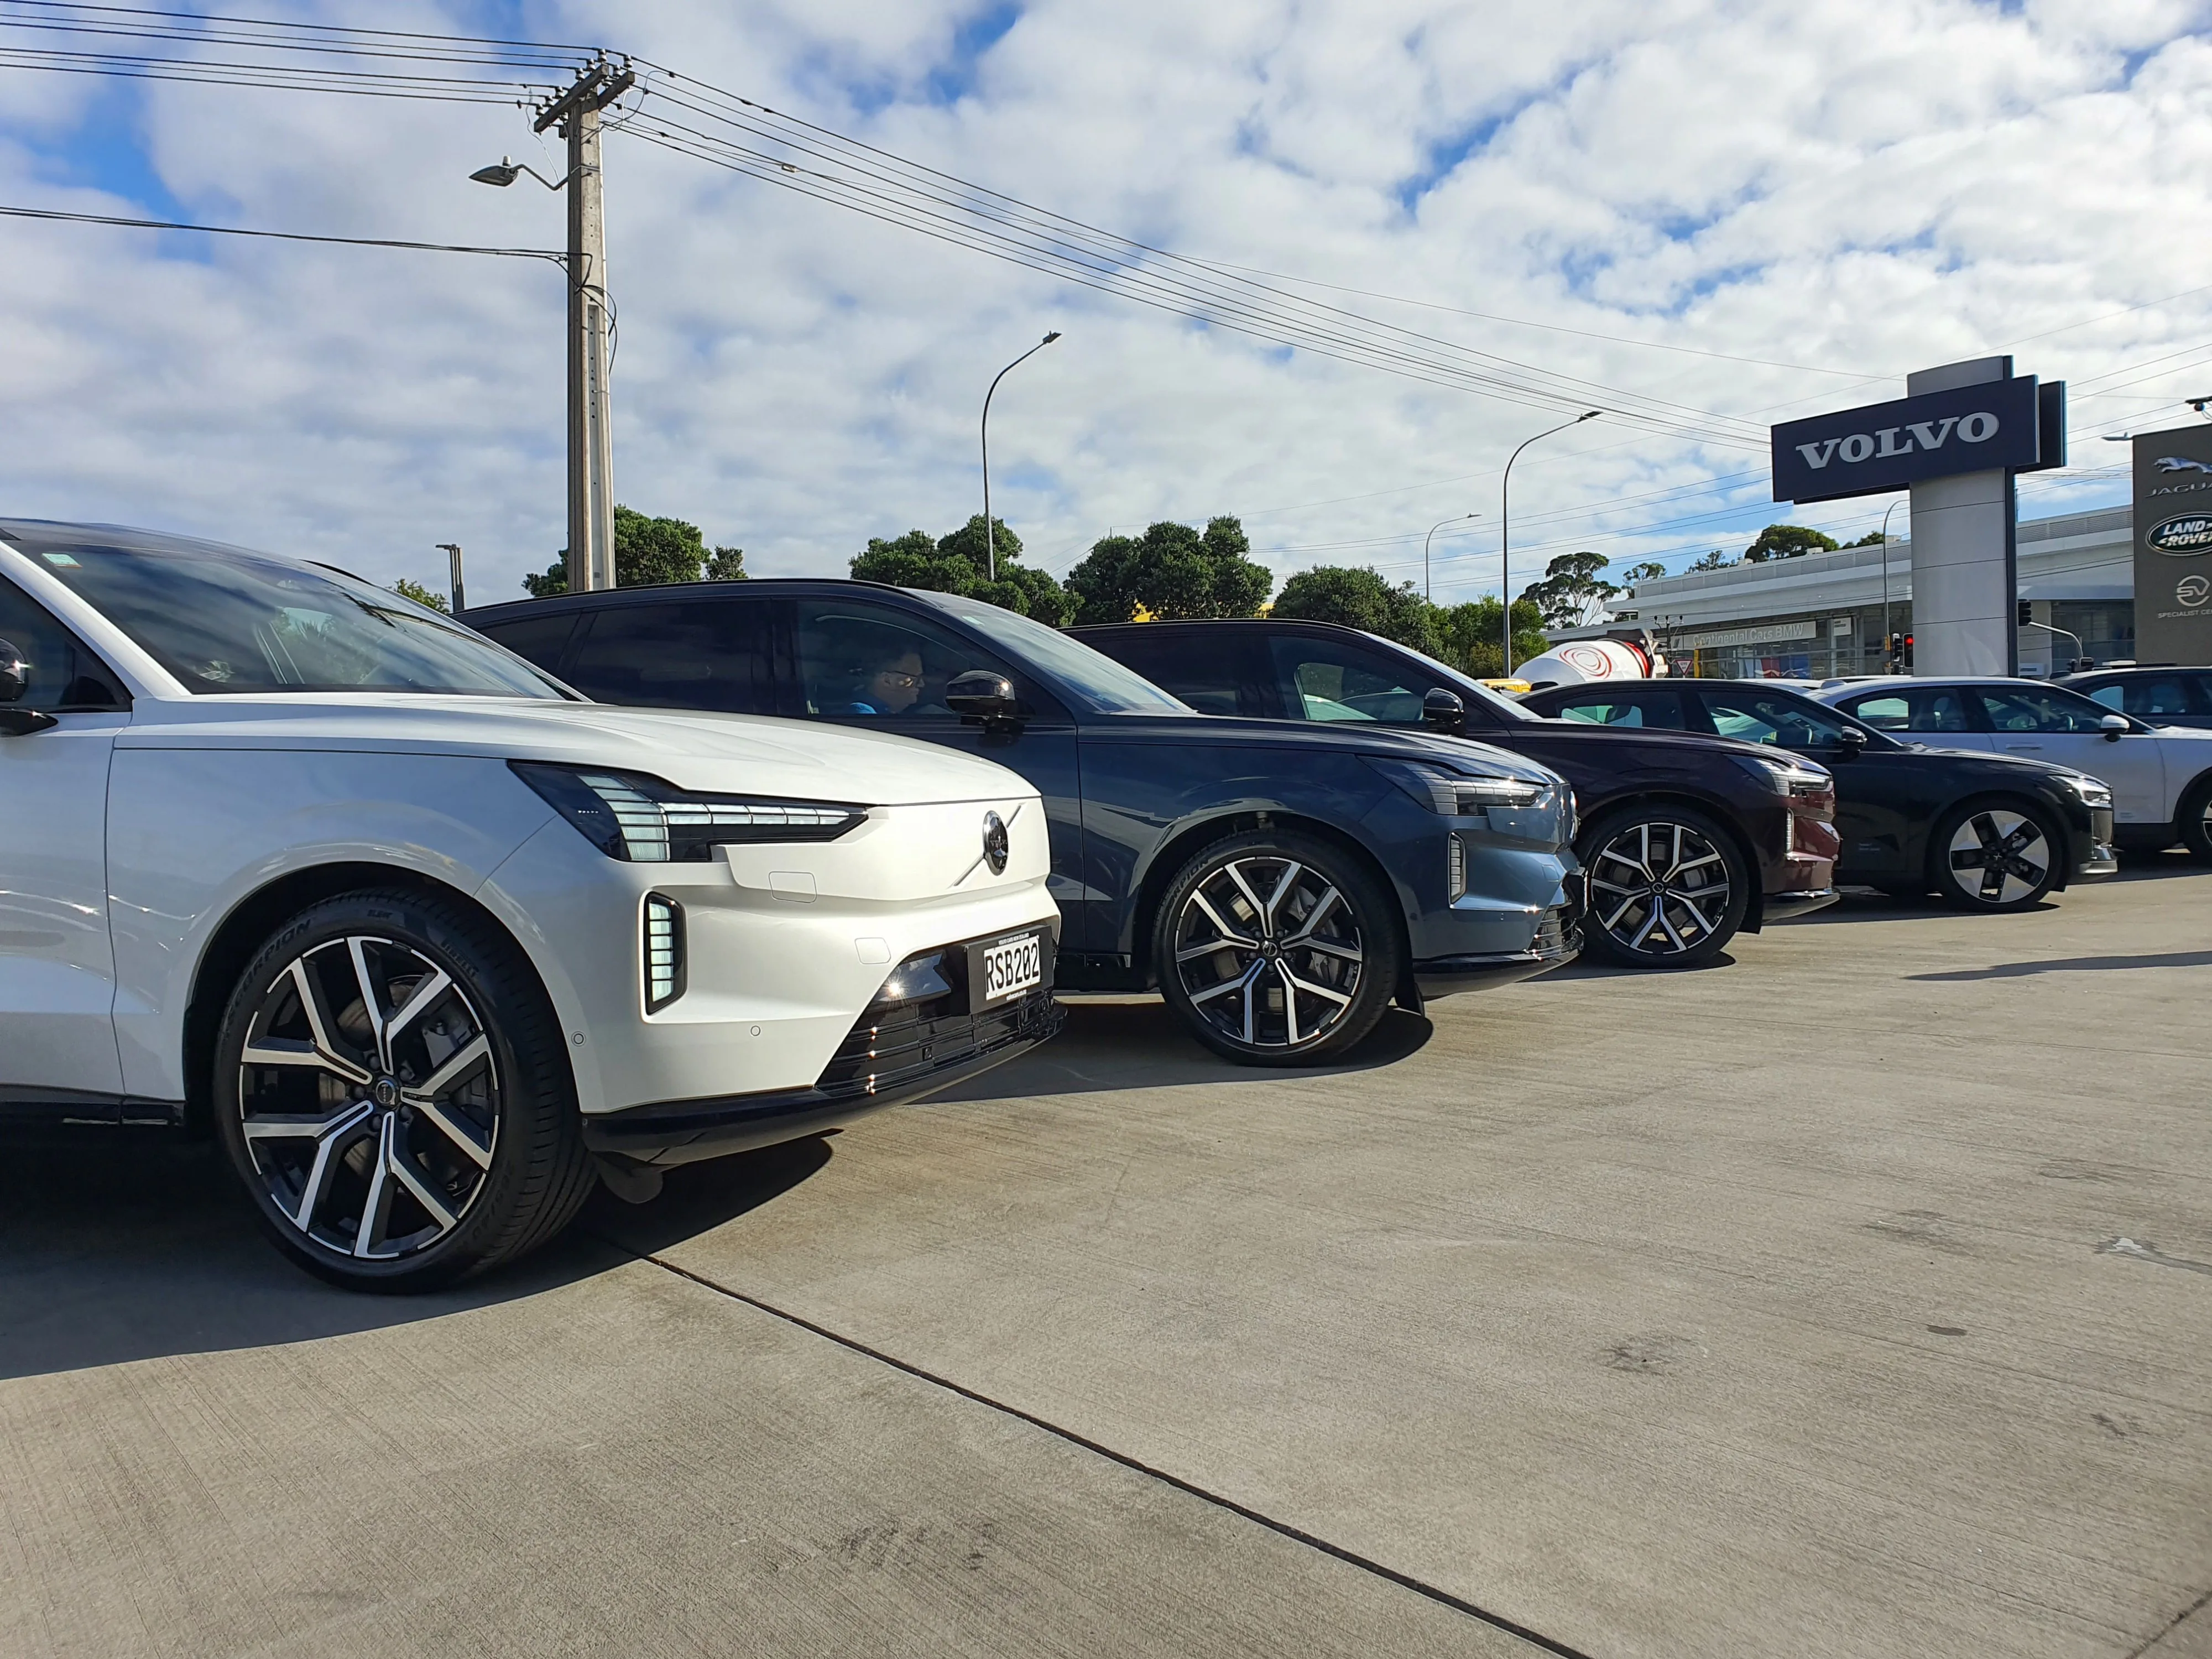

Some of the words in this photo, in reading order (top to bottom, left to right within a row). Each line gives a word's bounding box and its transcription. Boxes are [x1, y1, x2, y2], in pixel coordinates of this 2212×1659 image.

[1795, 411, 2000, 469] VOLVO
[2163, 520, 2206, 535] LAND
[2158, 609, 2199, 619] SPECIALIST
[1692, 633, 1747, 646] Continental
[1750, 628, 1773, 641] Cars
[1775, 623, 1804, 638] BMW
[985, 943, 1039, 993] RSB202
